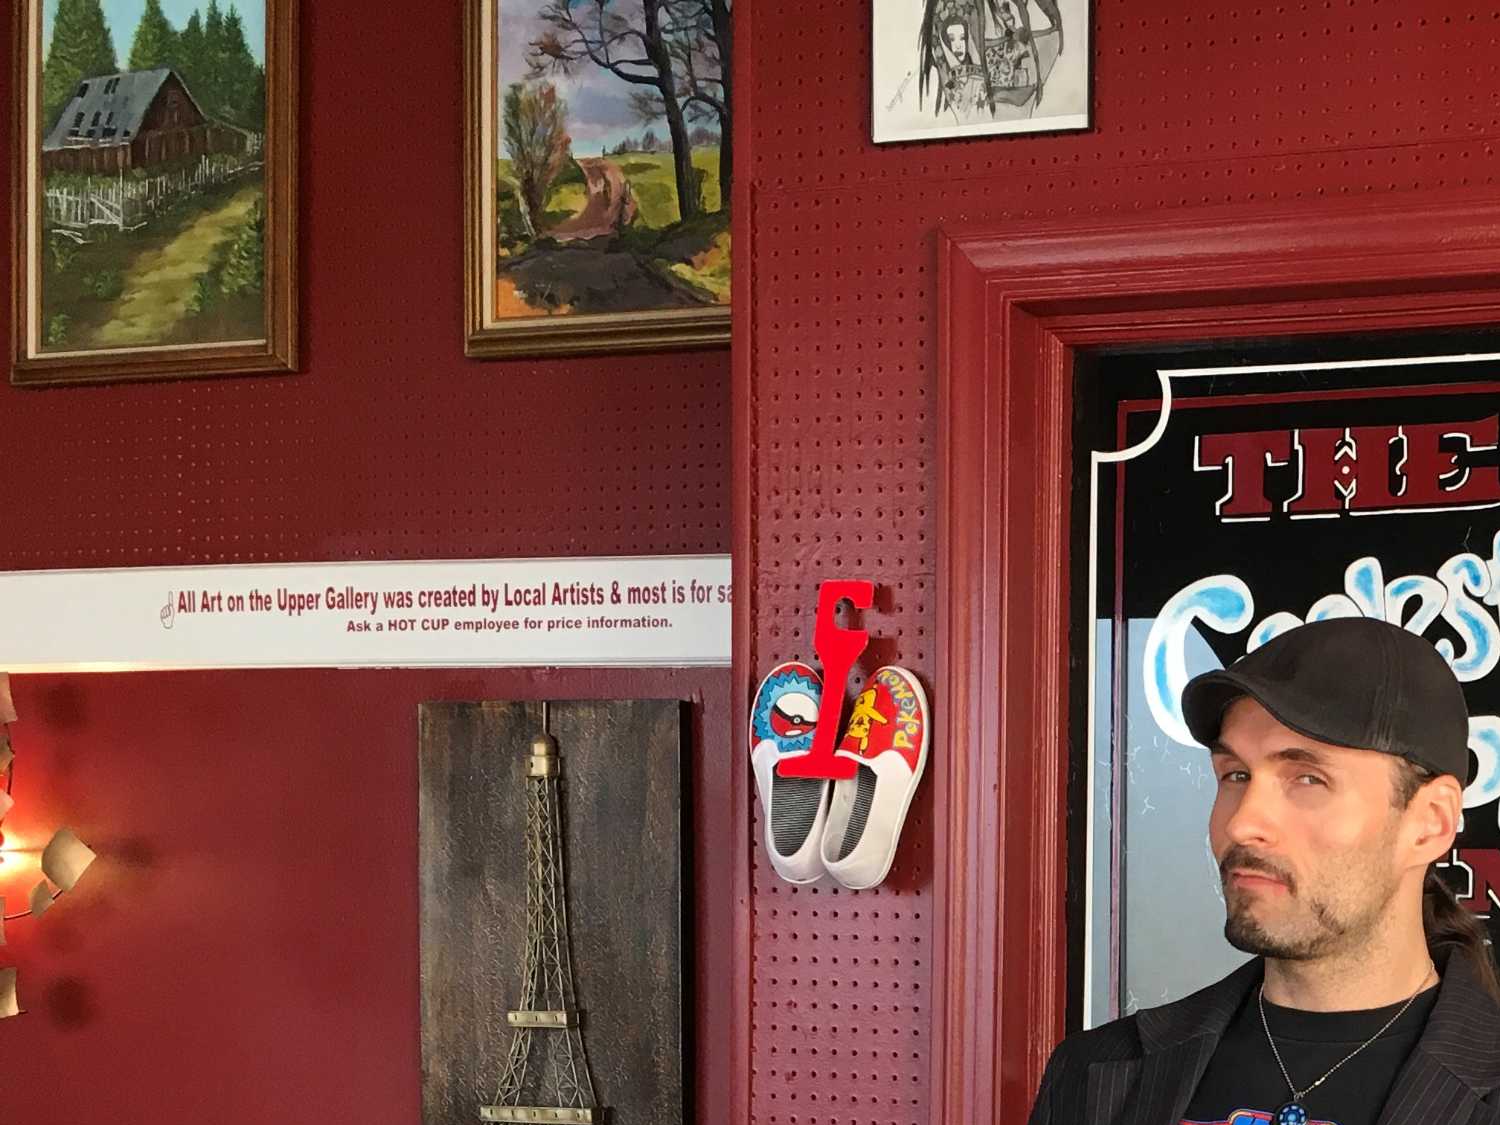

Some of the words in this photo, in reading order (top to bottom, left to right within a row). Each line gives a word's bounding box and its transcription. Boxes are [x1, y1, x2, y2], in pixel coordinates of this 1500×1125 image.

[177, 590, 196, 613] All
[200, 589, 223, 613] Art
[227, 597, 245, 612] on
[248, 588, 273, 611] the
[276, 588, 321, 617] Upper
[325, 586, 379, 615] Gallery
[383, 592, 413, 609] was
[418, 583, 477, 608] created
[481, 583, 499, 613] by
[504, 582, 546, 607] Local
[551, 581, 605, 606] Artists
[610, 580, 622, 605] &
[627, 584, 667, 605] most
[672, 580, 686, 604] is
[690, 579, 713, 604] for
[346, 620, 372, 632] Ask
[375, 622, 384, 632] a
[388, 619, 417, 632] HOT
[421, 618, 450, 631] CUP
[454, 617, 520, 633] employee
[524, 617, 543, 630] for
[547, 616, 583, 632] price
[587, 615, 673, 630] information.
